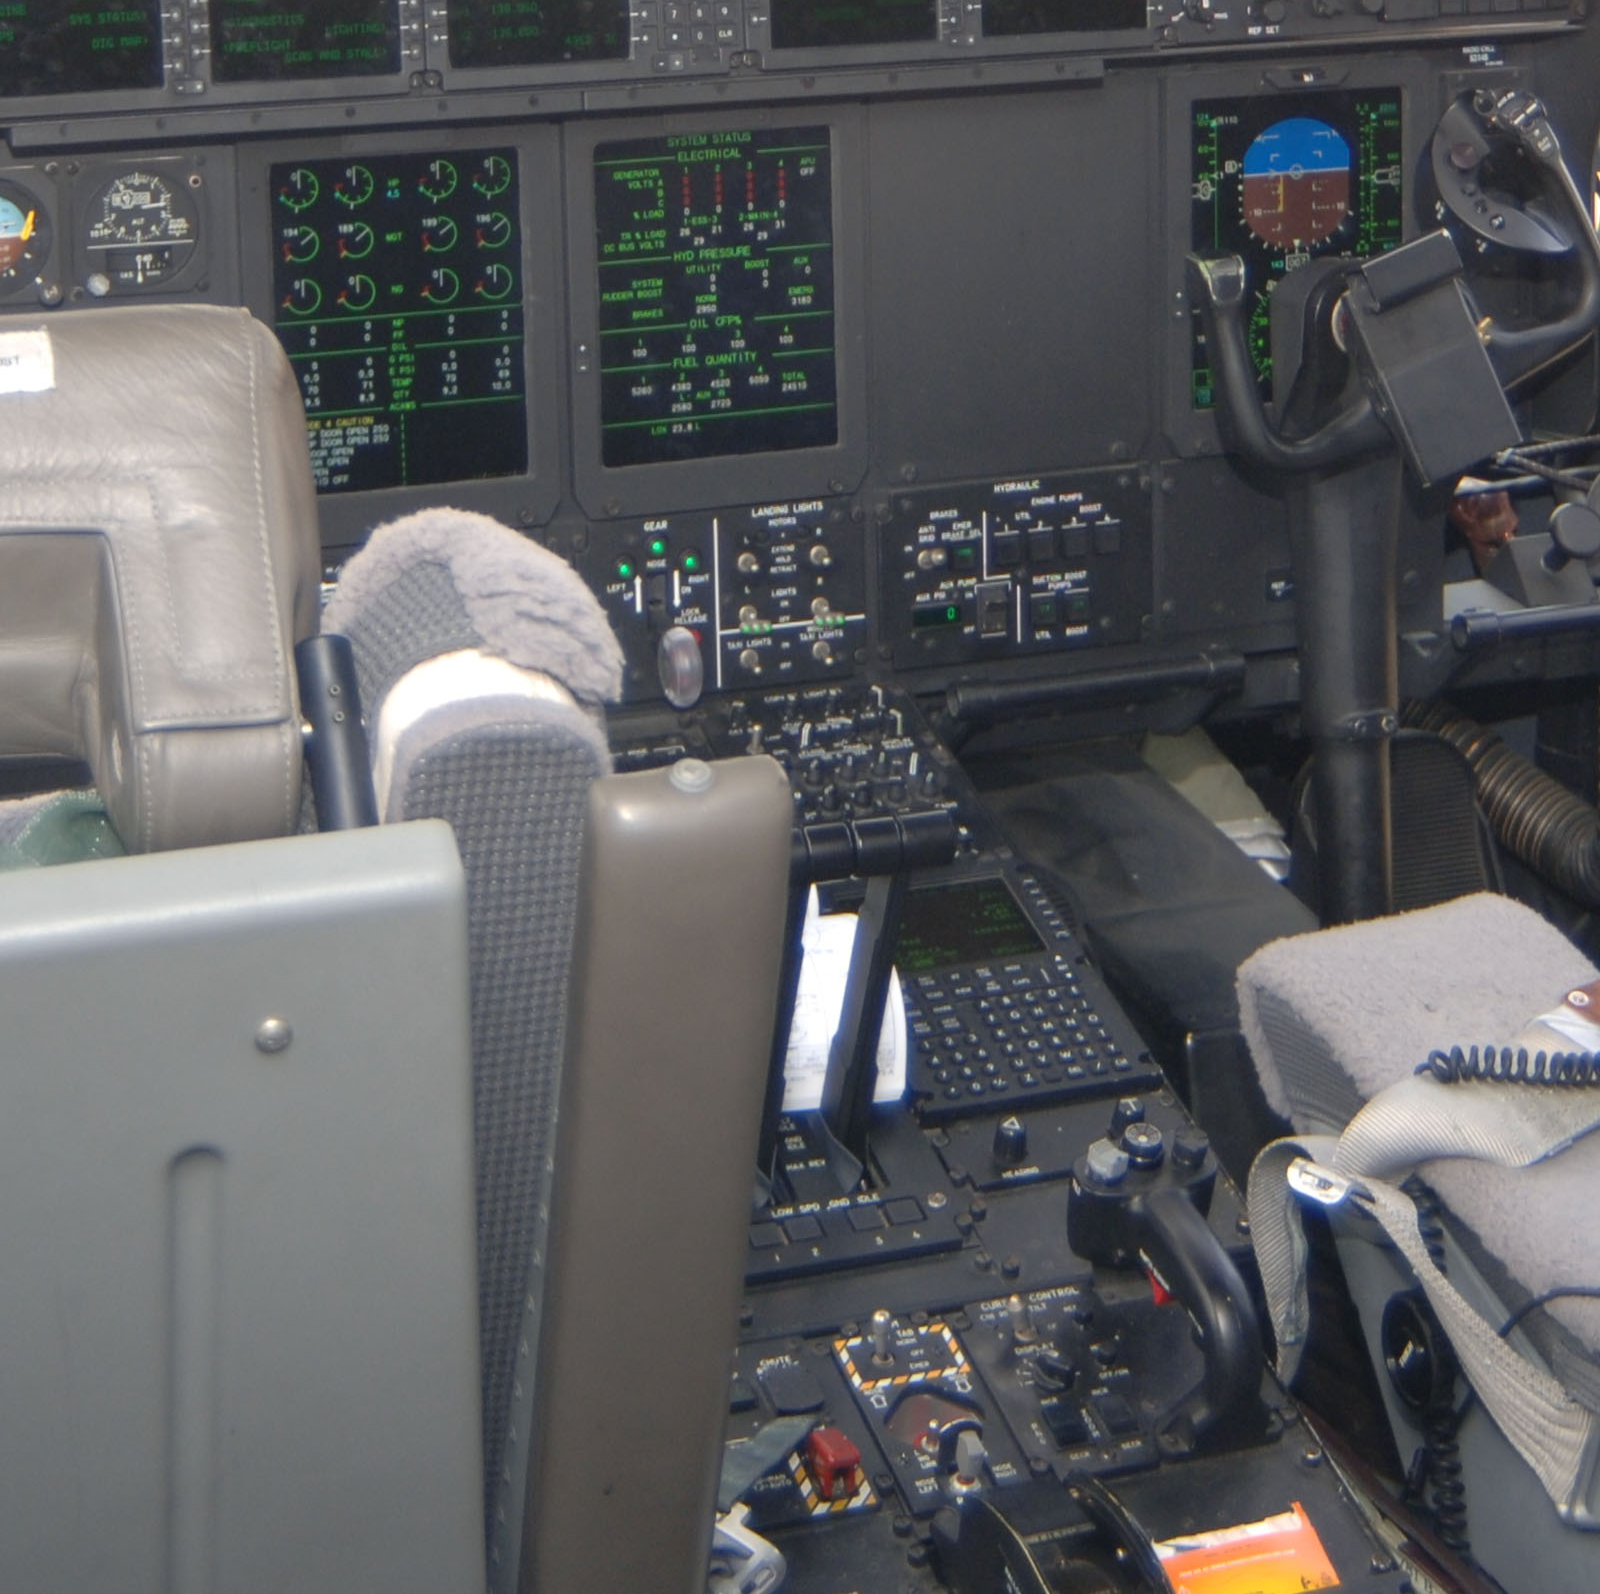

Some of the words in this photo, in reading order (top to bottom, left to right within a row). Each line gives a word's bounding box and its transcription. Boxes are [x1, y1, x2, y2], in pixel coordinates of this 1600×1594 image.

[1248, 27, 1262, 35] REF
[1266, 26, 1280, 34] SET
[667, 135, 707, 147] SYSTEM
[712, 132, 751, 143] STATUS
[677, 148, 741, 162] ELECTRICAL
[613, 169, 660, 180] GENERATOR
[643, 209, 664, 219] LOAD
[637, 240, 665, 251] VOLTS
[674, 250, 694, 262] HYD
[699, 246, 750, 260] PRESSURE
[686, 263, 721, 274] UTILITY
[632, 279, 664, 289] SYSTEM
[637, 288, 662, 299] BOOST
[632, 308, 664, 319] BRAKES
[690, 318, 709, 329] OIL
[673, 357, 699, 368] FUEL
[705, 352, 757, 365] QUANTITY
[994, 480, 1040, 493] HYDRAULIC
[1031, 495, 1056, 506] ENGINE
[1059, 493, 1083, 503] PUMPS
[751, 505, 788, 518] LANDING
[793, 501, 823, 513] LIGHTS
[1079, 503, 1101, 514] BOOST
[929, 510, 958, 520] BRAKES
[644, 521, 668, 532] GEAR
[768, 517, 797, 527] MOTORS
[952, 521, 972, 530] EMER
[918, 525, 935, 535] ANTI
[918, 533, 935, 543] SKID
[647, 559, 667, 568] NOSE
[688, 574, 710, 584] RIGHT
[957, 577, 977, 587] PUMP
[1032, 573, 1062, 585] SUCTION
[1064, 570, 1087, 581] BOOST
[607, 583, 626, 594] LEFT
[1048, 579, 1072, 590] PUMPS
[771, 587, 797, 598] LIGHTS
[915, 592, 931, 602] AUX
[674, 614, 708, 625] RELEASE
[818, 629, 844, 639] LIGHTS
[1065, 625, 1088, 636] BOOST
[746, 638, 772, 648] LIGHTS
[771, 1207, 794, 1218] LOW
[799, 1202, 820, 1214] SPD
[828, 1198, 850, 1208] GND
[856, 1192, 880, 1204] IDLE
[1028, 1286, 1079, 1302] CONTROL
[918, 1484, 939, 1494] LEFT
